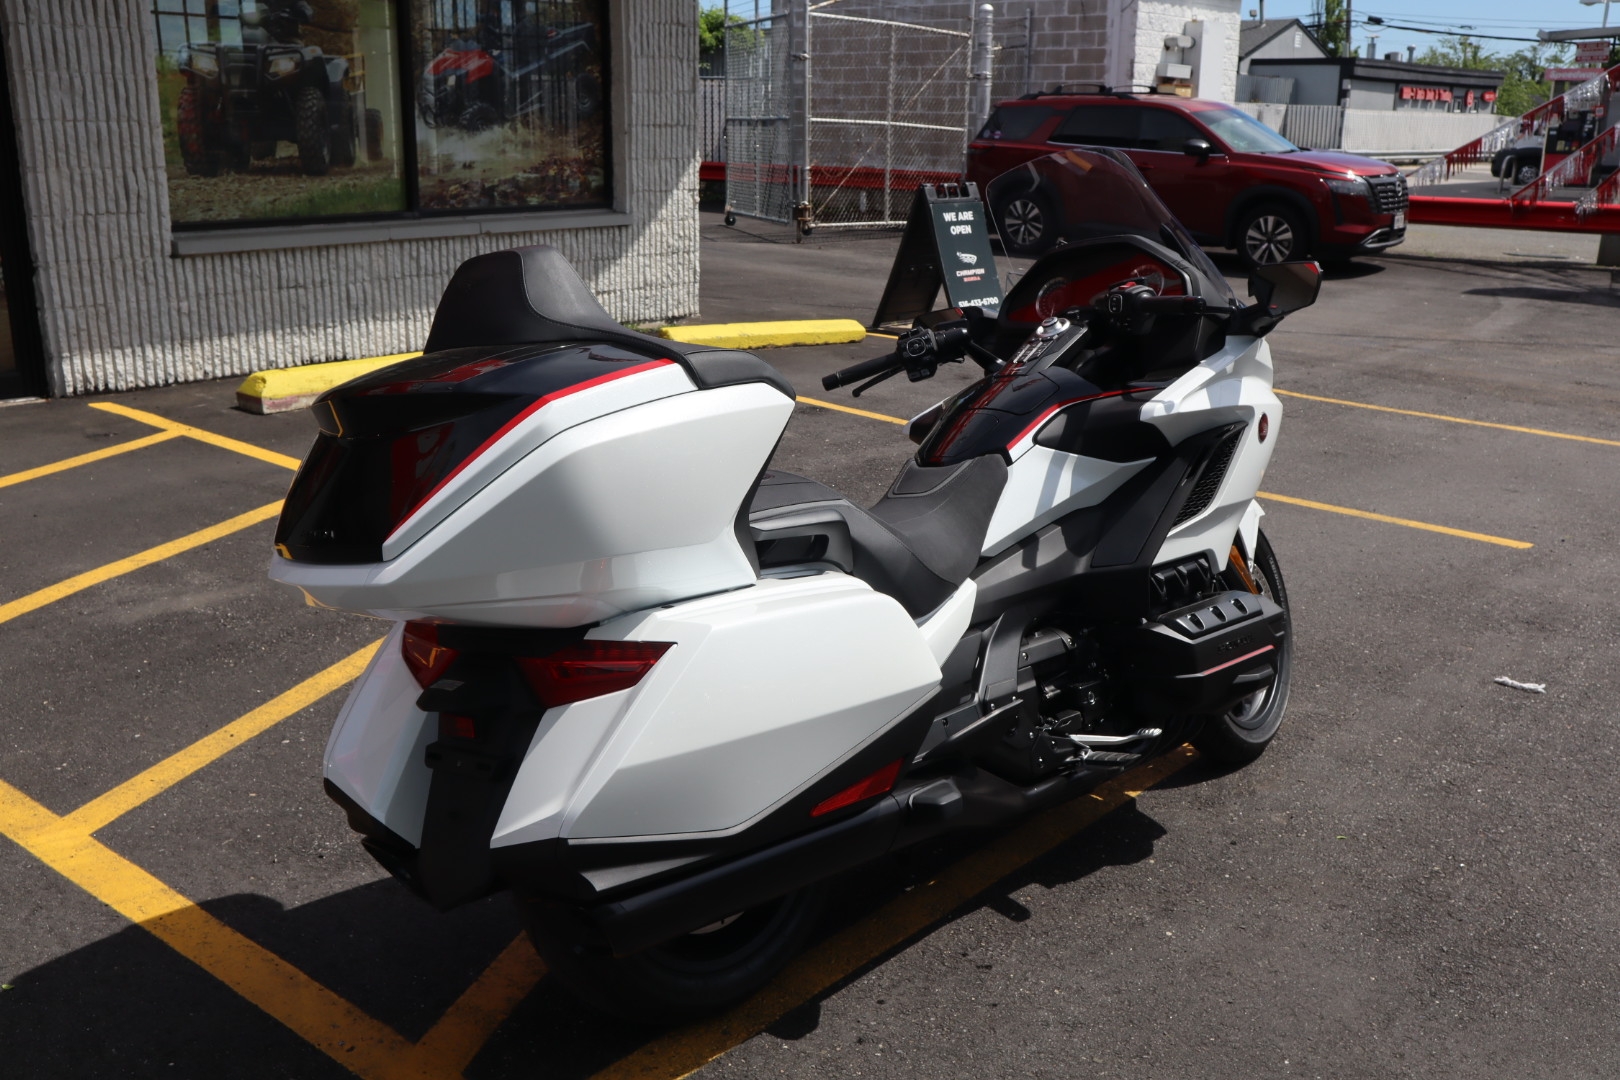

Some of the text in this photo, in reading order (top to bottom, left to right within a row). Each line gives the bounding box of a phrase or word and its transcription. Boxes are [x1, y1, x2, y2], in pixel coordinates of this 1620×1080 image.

[943, 211, 974, 222] WE ARE
[950, 225, 972, 235] OPEN
